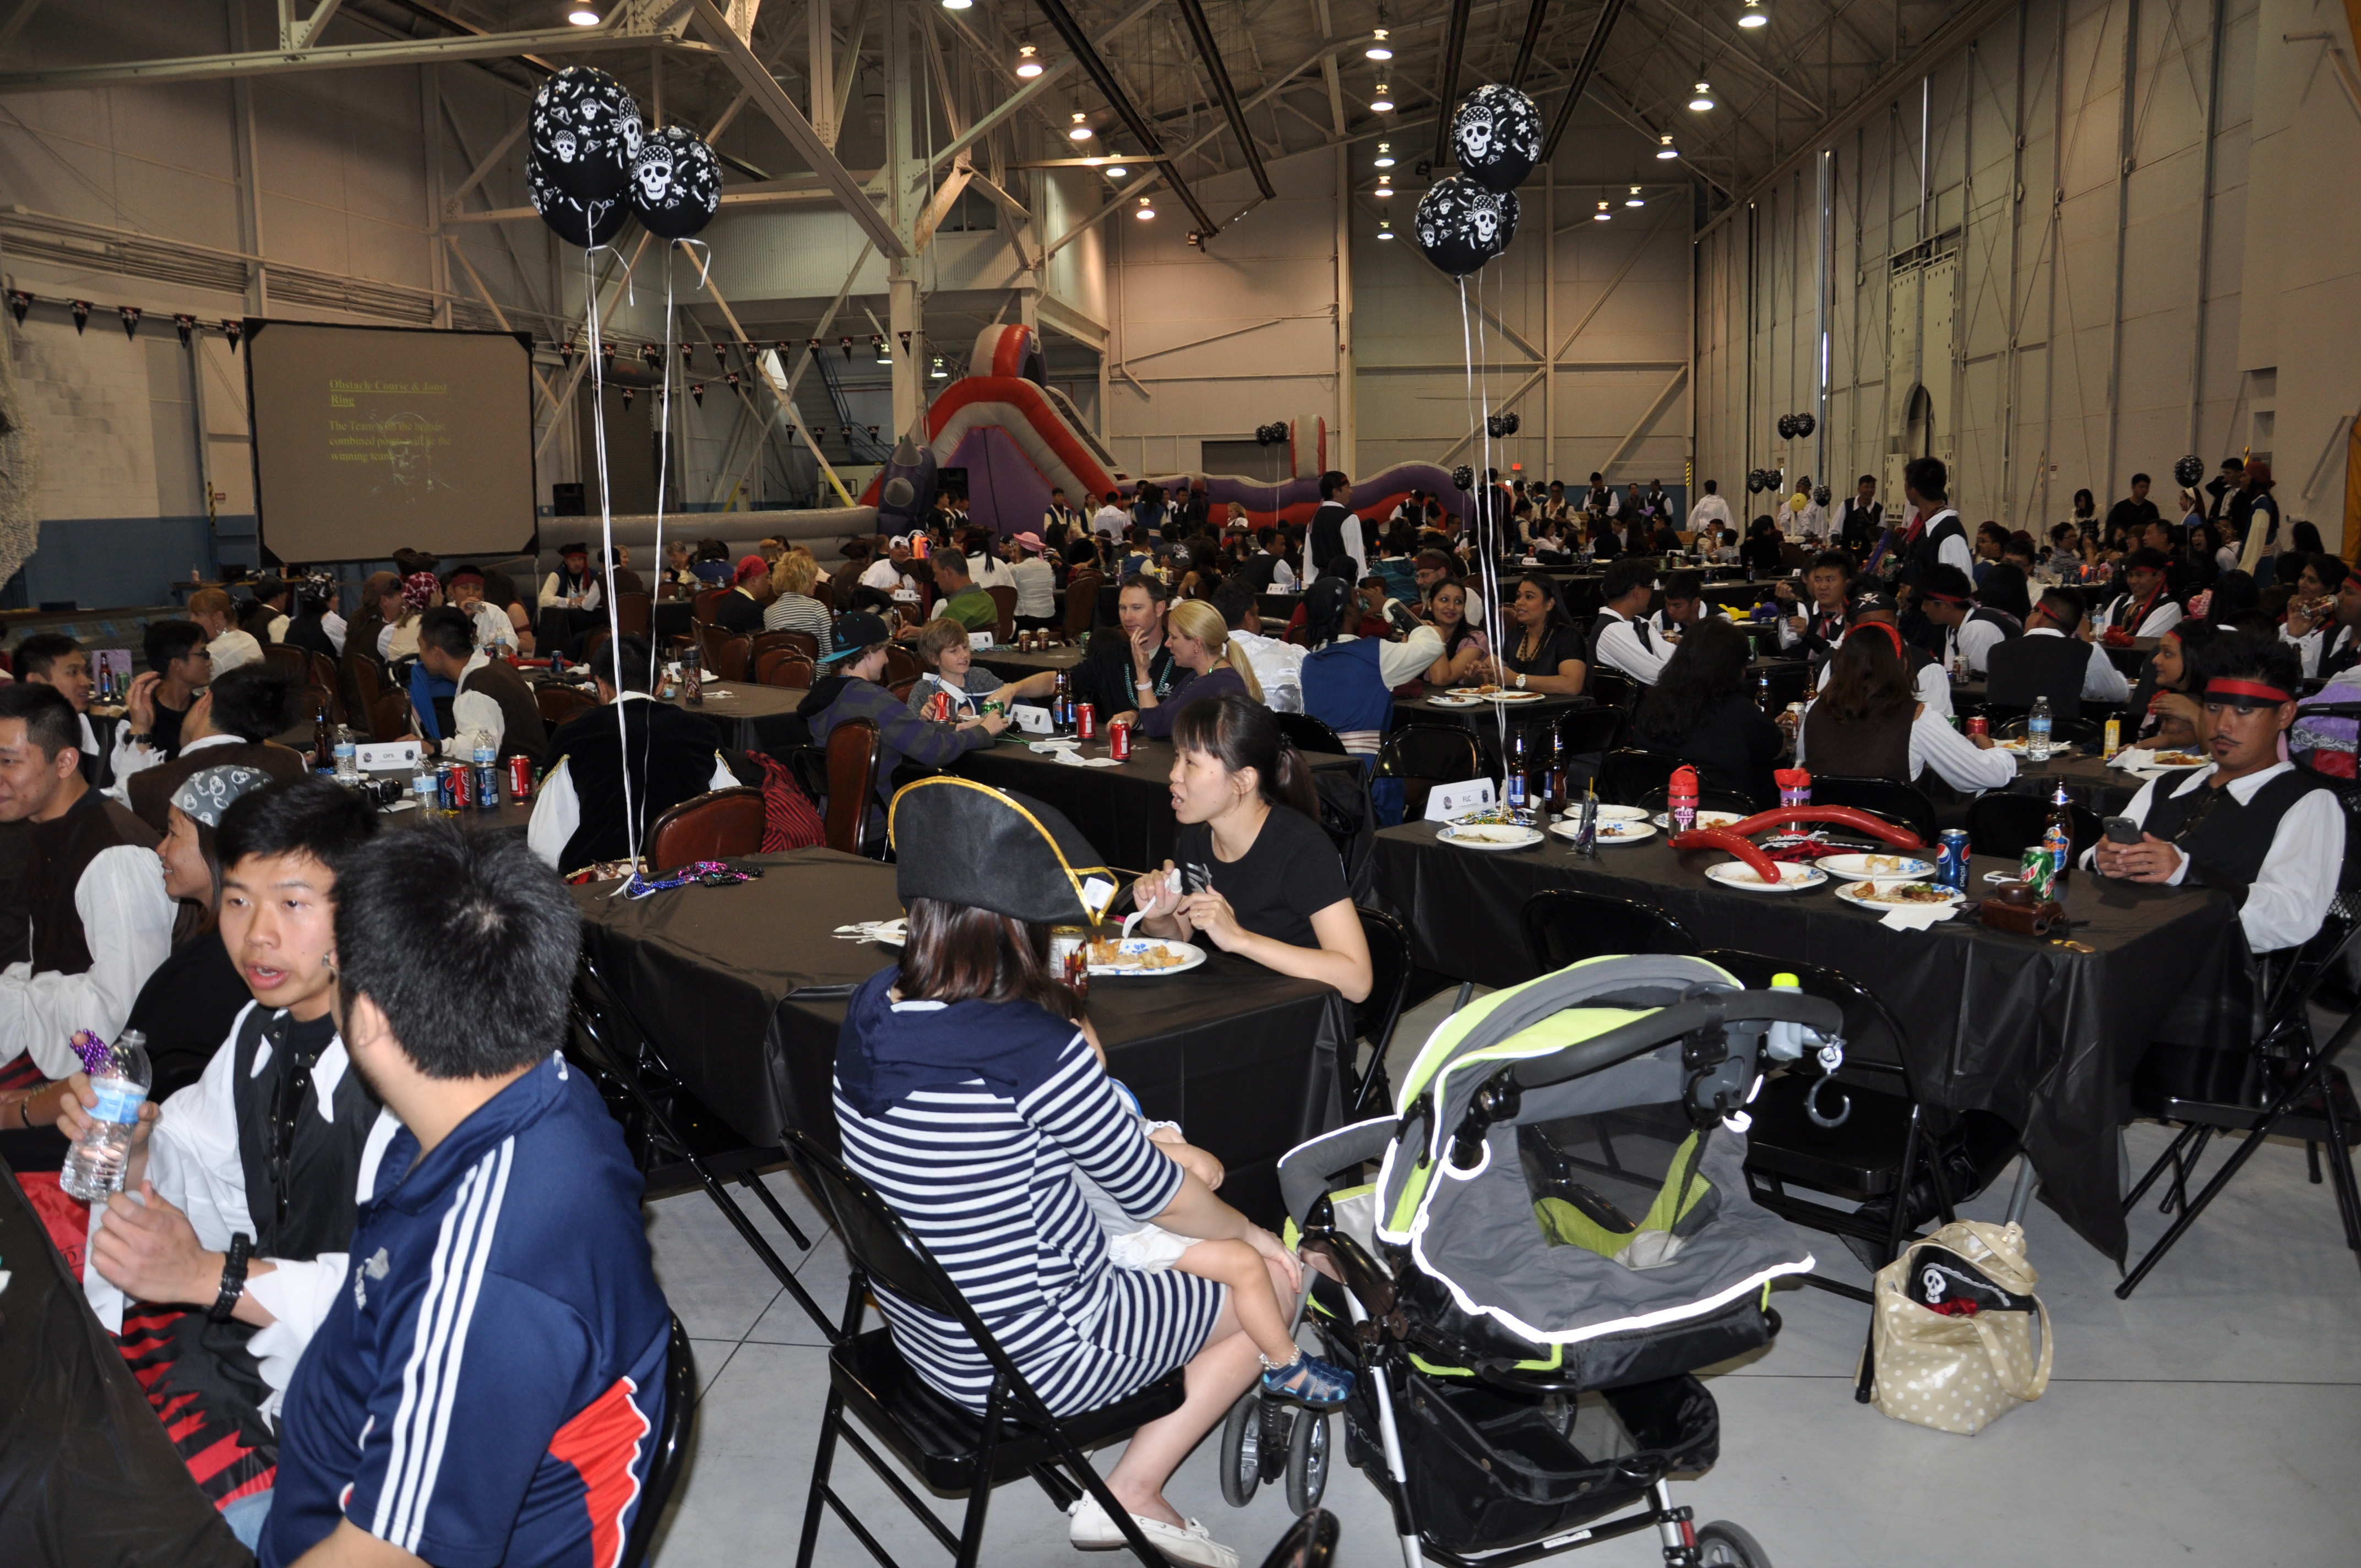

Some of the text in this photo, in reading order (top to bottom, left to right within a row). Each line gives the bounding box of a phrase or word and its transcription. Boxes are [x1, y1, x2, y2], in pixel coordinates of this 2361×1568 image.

[330, 380, 447, 392] Obstacle Course & Joust
[331, 395, 354, 406] Ring
[330, 421, 346, 431] The
[350, 421, 374, 431] Team
[399, 422, 412, 431] the
[415, 422, 446, 433] highest
[330, 435, 374, 445] combined
[438, 435, 451, 445] the
[331, 451, 368, 462] winning
